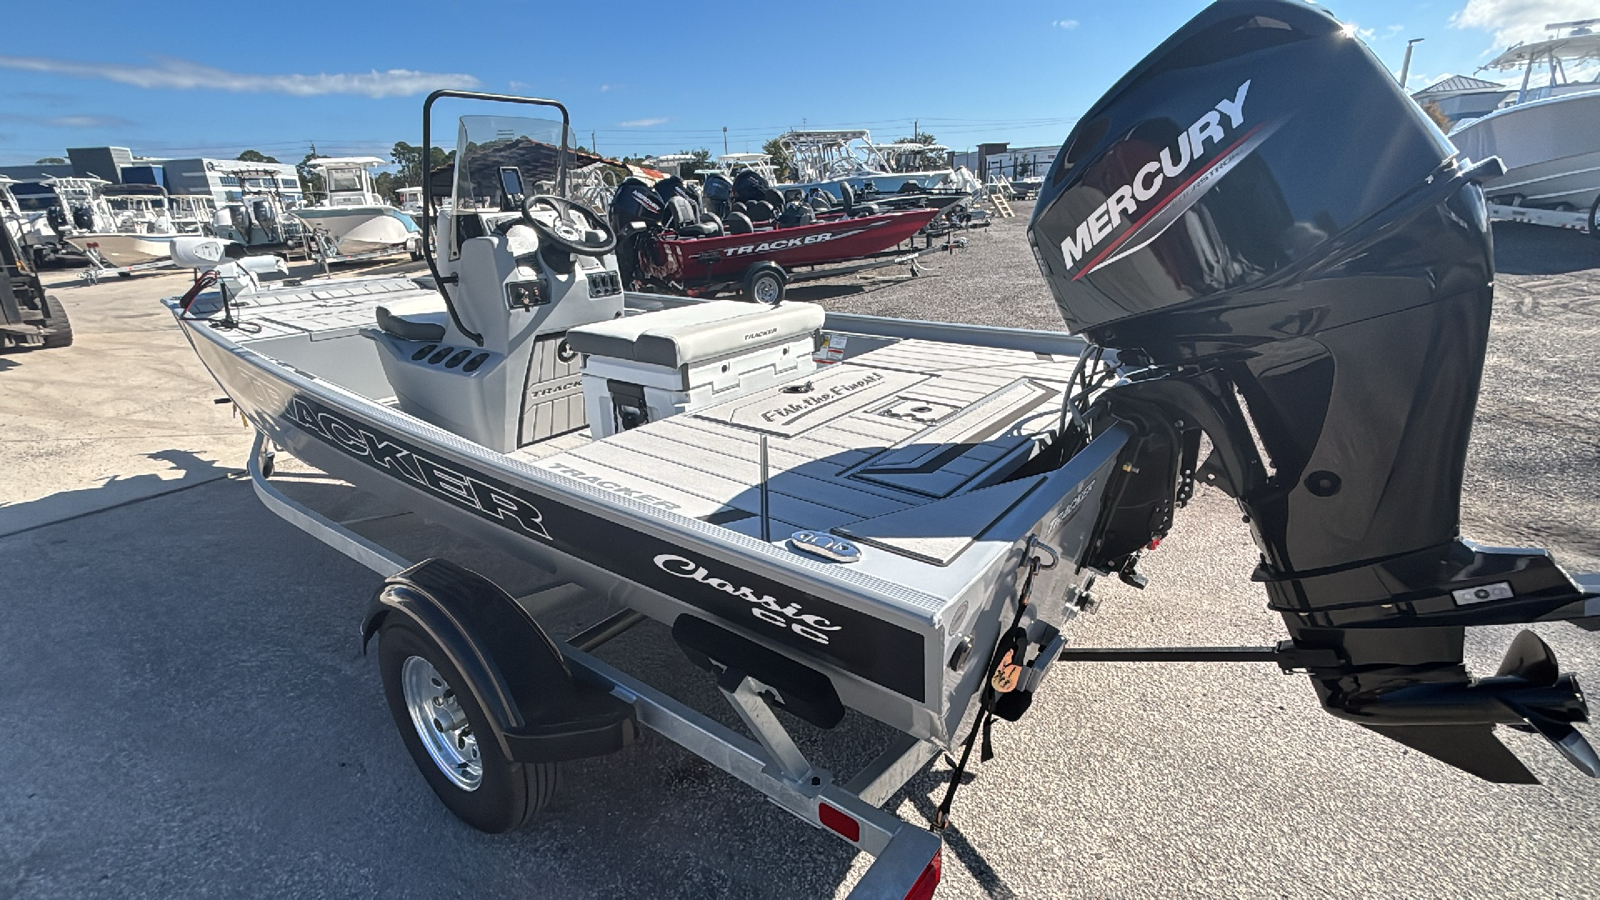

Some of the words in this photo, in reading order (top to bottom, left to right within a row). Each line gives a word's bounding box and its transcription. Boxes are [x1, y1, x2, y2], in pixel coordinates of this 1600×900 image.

[1060, 79, 1251, 270] MERCURY
[724, 233, 832, 256] TRACKER
[744, 327, 778, 341] TRACKER
[549, 463, 682, 511] TRACKER
[653, 553, 842, 631] Classic
[752, 607, 829, 644] CC
